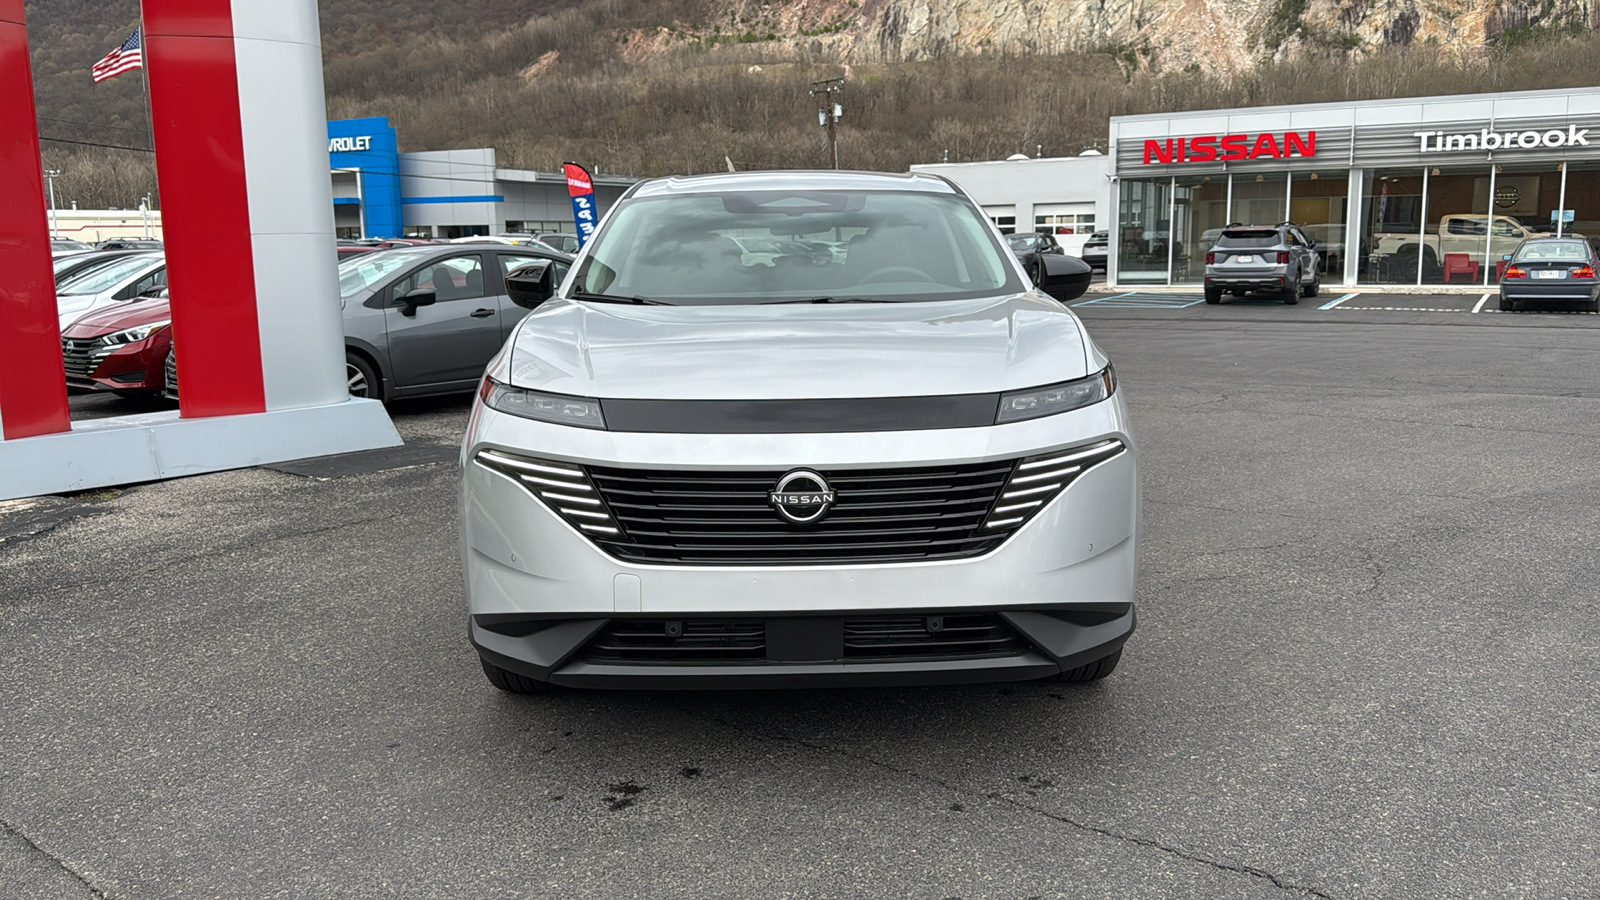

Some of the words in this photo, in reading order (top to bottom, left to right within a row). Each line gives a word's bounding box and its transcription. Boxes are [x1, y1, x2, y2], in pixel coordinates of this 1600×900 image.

[1143, 131, 1316, 164] NISSAN
[1413, 124, 1591, 153] Timbrook
[772, 494, 833, 504] NISSAN
